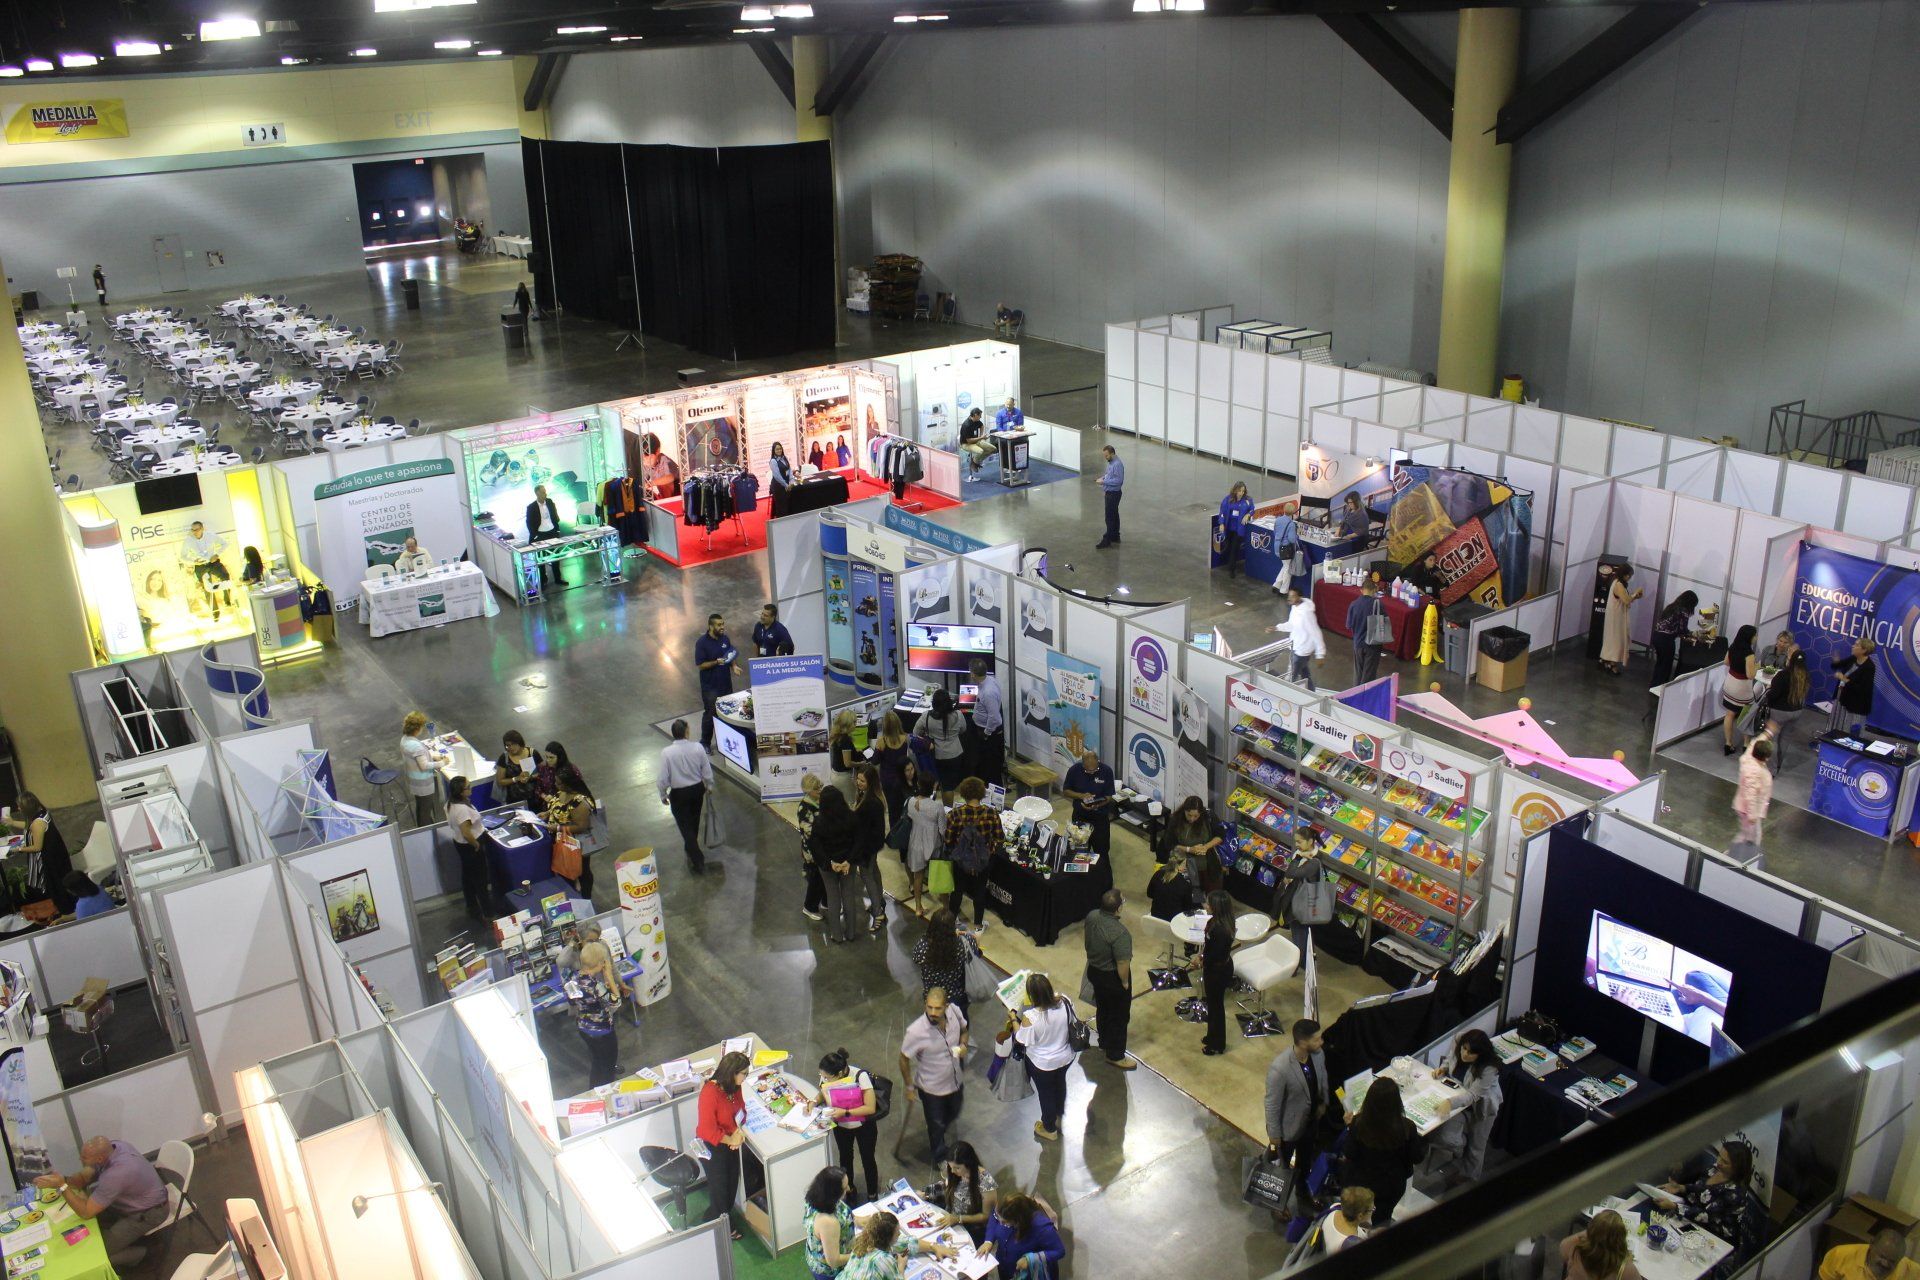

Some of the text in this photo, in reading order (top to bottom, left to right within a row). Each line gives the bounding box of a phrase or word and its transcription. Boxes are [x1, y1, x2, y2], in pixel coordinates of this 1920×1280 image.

[32, 105, 97, 122] MEDALLA
[394, 111, 433, 129] EXIT
[56, 123, 82, 136] Light
[323, 463, 442, 494] Estudia lo que te apasiona
[384, 486, 424, 499] Doctorados
[361, 502, 411, 519] CENTRO DE
[362, 510, 412, 527] ESTUDIOS
[130, 524, 165, 541] PISE
[363, 519, 414, 534] AVANZADOS
[1439, 532, 1484, 574] CTION
[1801, 582, 1875, 612] EDUCACIÓN DE
[1796, 598, 1903, 651] EXCELENCIA
[262, 627, 272, 646] PISE
[752, 661, 789, 670] DISEÑAMOS
[1236, 691, 1262, 707] Sadlier
[1313, 720, 1348, 742] Sadlier
[1434, 772, 1464, 790] Sadlier
[1818, 766, 1857, 788] EXCELENCIA
[633, 882, 657, 896] JOVI
